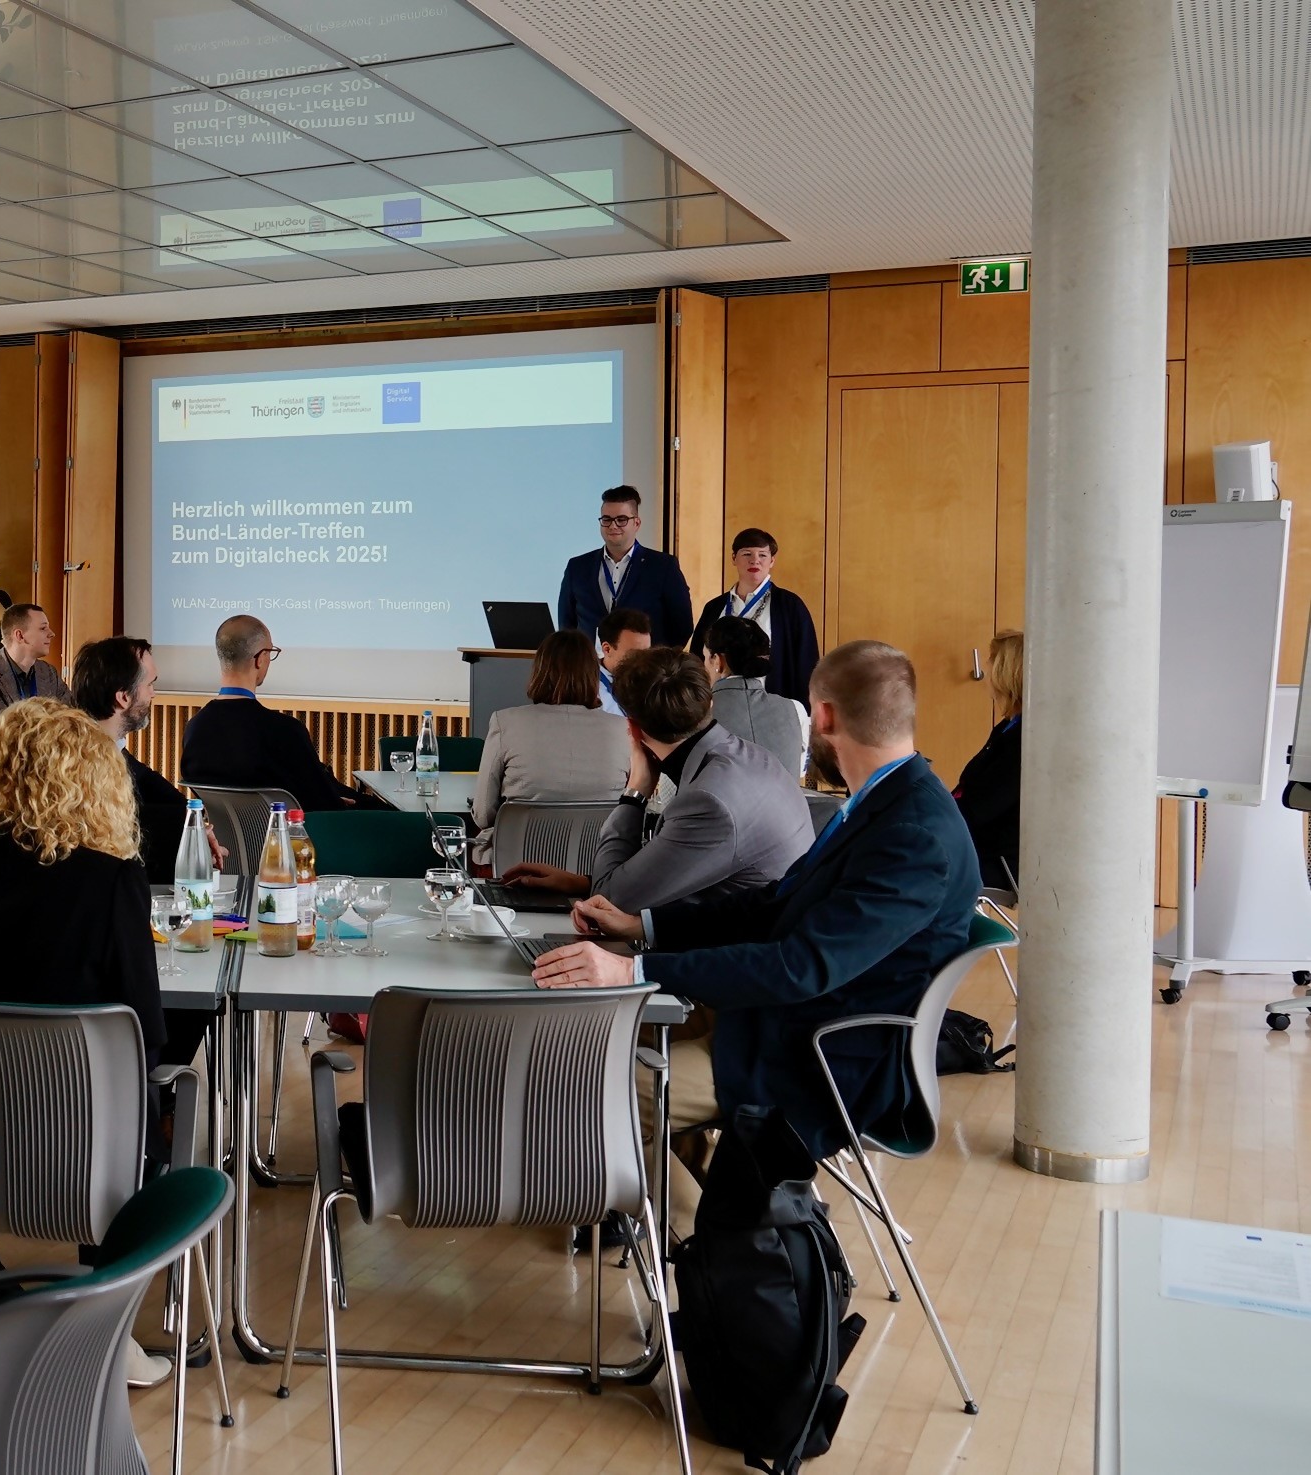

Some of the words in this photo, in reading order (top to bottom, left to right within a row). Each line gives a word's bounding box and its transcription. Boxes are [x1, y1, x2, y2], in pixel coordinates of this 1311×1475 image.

[386, 388, 410, 396] Digital
[279, 397, 304, 405] Freistaat
[251, 405, 305, 419] Thüringen
[172, 501, 245, 518] Herzlich
[251, 499, 365, 517] willkommen
[371, 500, 413, 514] zum
[172, 522, 365, 541] Bund-Länder-Treffen
[171, 551, 209, 565] zum
[215, 547, 330, 567] Digitalcheck
[336, 546, 387, 563] 2025!
[172, 597, 253, 612] WLAN-Zugang:
[257, 597, 311, 610] TSK-Gast
[379, 598, 450, 612] Thueringen)
